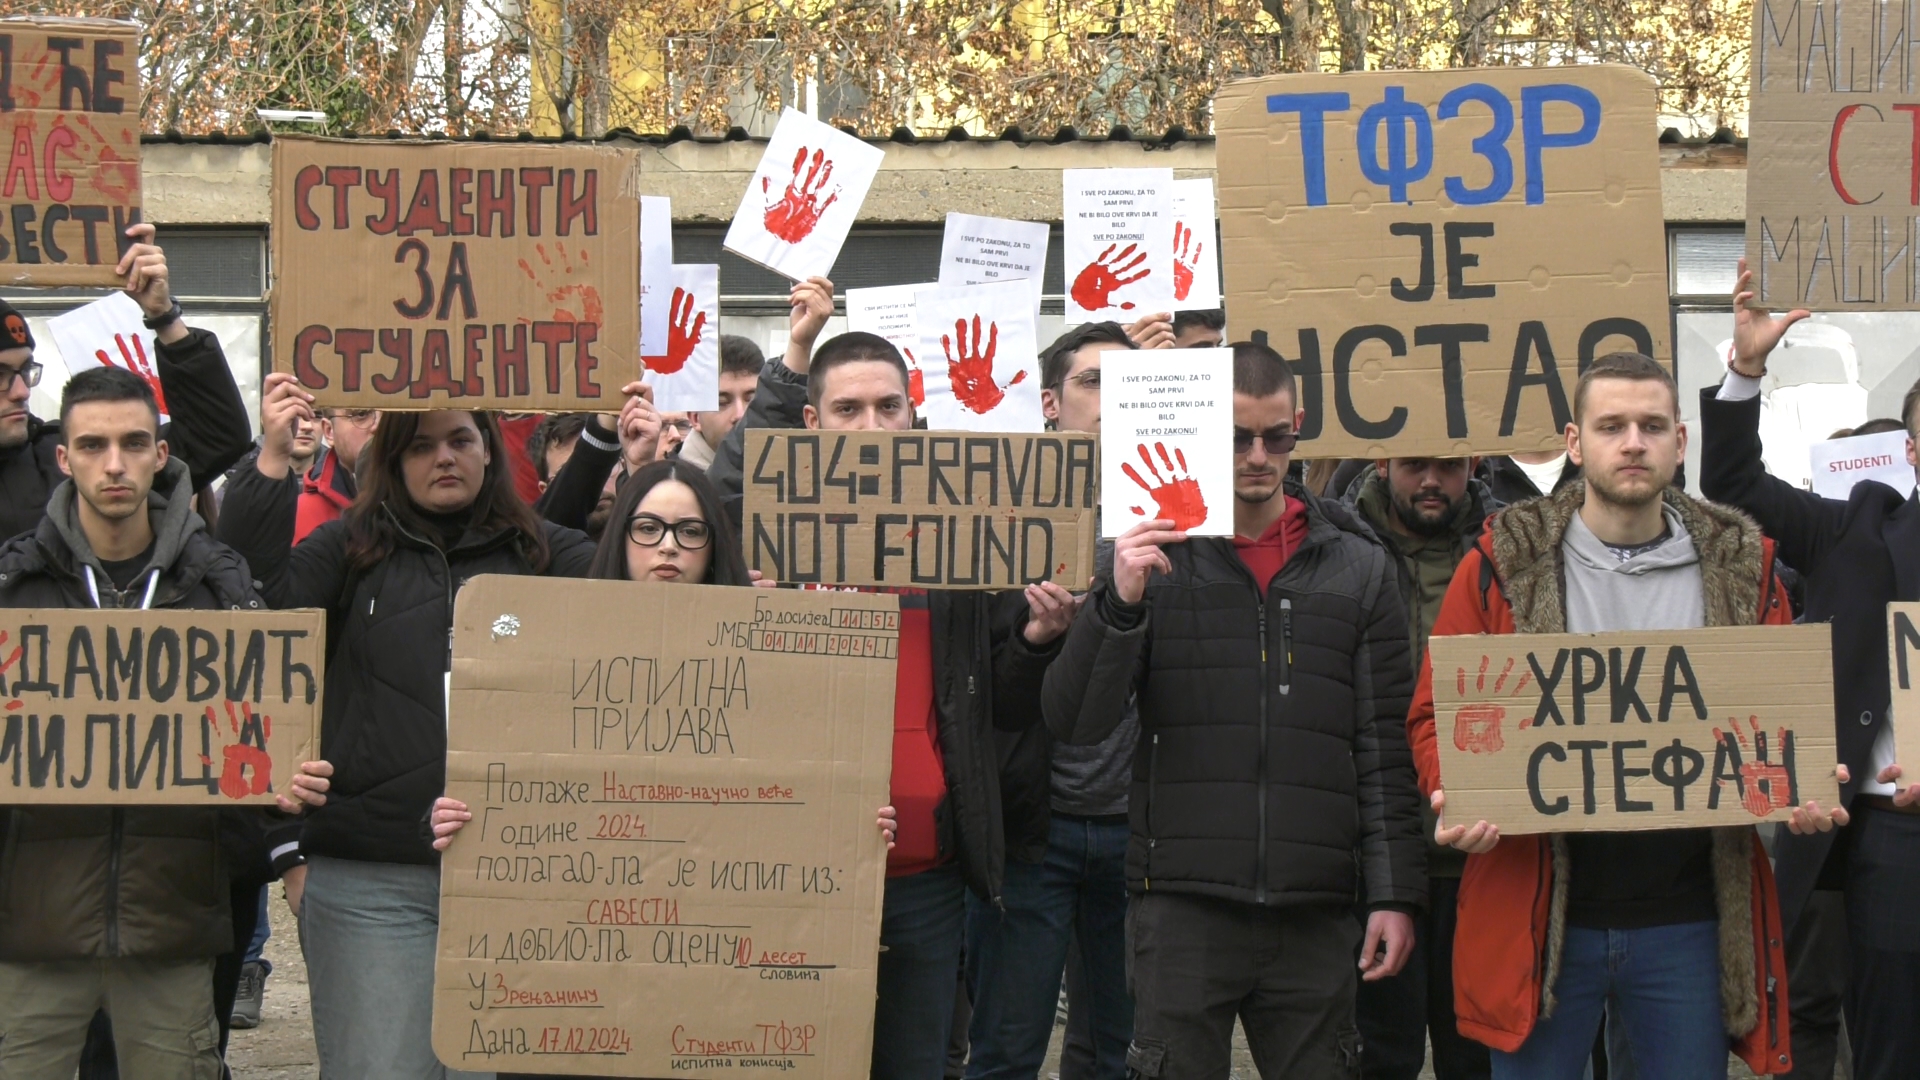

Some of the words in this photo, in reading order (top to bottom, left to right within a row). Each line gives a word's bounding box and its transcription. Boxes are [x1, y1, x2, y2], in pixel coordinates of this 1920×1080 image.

[1266, 83, 1602, 207] ТФЗР
[294, 164, 598, 238] СТУДЕНТИ
[964, 235, 975, 243] SVE
[986, 238, 1012, 248] ZAKONU,
[995, 249, 1009, 257] PRVI
[1389, 221, 1497, 302] ЈЕ
[1761, 216, 1920, 303] МАШИ
[393, 237, 478, 320] ЗА
[972, 258, 986, 266] BILO
[986, 260, 998, 268] OVE
[985, 270, 999, 278] BILO
[293, 321, 601, 399] СТУДЕНТЕ
[1126, 375, 1140, 383] SVE
[1154, 374, 1188, 382] ZAKONU,
[1158, 413, 1176, 421] BILO
[1194, 400, 1206, 408] DA
[1135, 428, 1149, 436] SVE
[1163, 427, 1198, 435] ZAKONU!
[752, 434, 880, 505] 404:
[891, 436, 1096, 508] PRAVDA
[1829, 454, 1893, 473] STUDENTI
[752, 512, 859, 583] NOT
[873, 514, 1054, 586] FOUND
[0, 624, 318, 705] ДАМОВИЋ
[572, 656, 749, 710] ИСПИТНА
[1526, 645, 1708, 727] ХРКА
[573, 706, 734, 755] ПРИЈАВА
[486, 762, 589, 804] Полаже
[603, 771, 750, 806] Наставно-научно
[757, 784, 794, 799] веће
[481, 807, 579, 850] Године
[596, 814, 647, 838] 2024.
[586, 898, 679, 925] САВЕСТИ
[758, 950, 807, 965] десет
[493, 973, 598, 1005] Зрењанину
[462, 1019, 531, 1061] Дана
[672, 1024, 756, 1057] Студенти
[755, 1020, 816, 1055] ТФЗР
[671, 1057, 733, 1071] испитна
